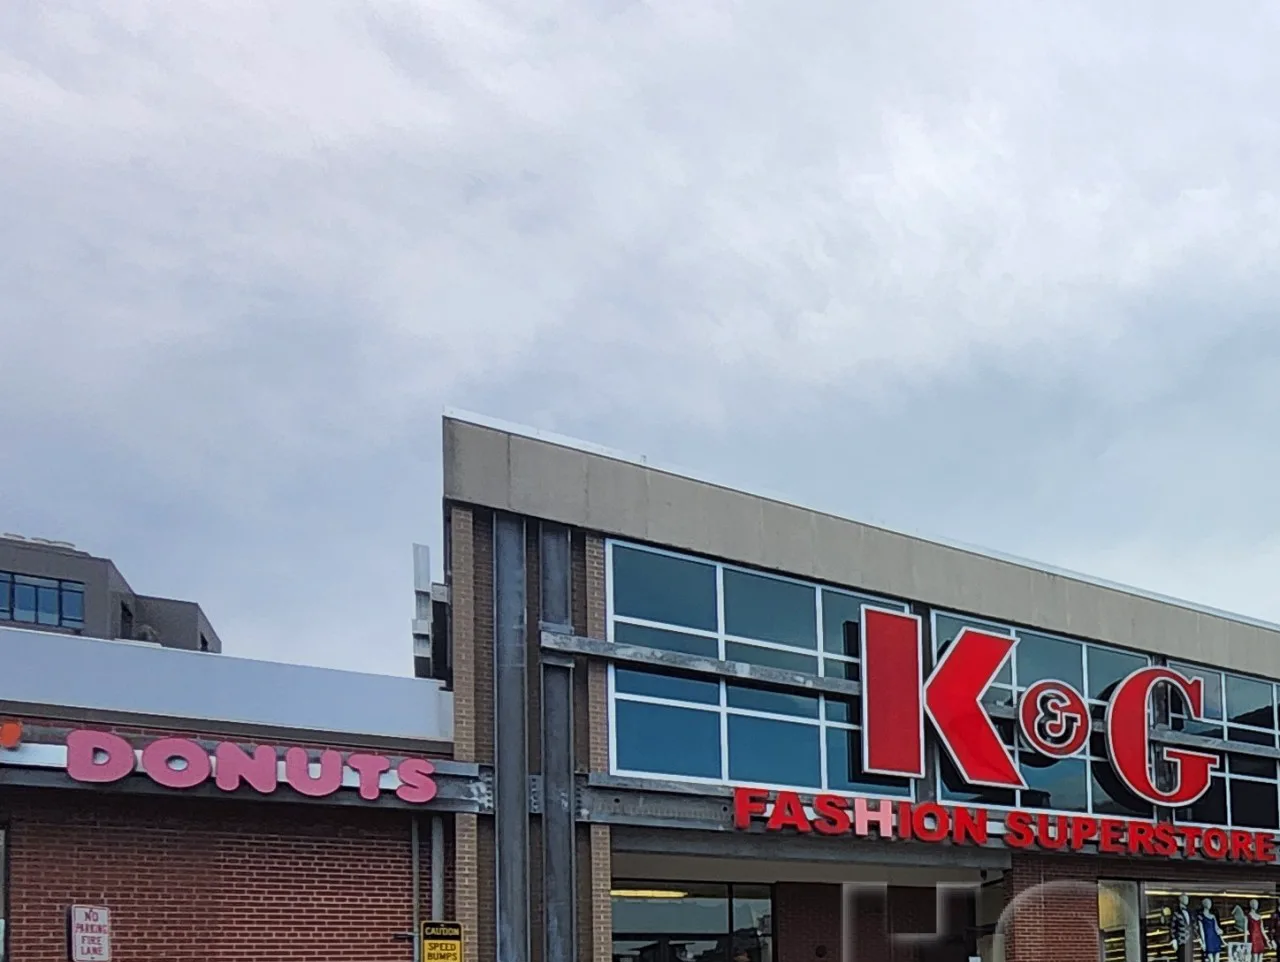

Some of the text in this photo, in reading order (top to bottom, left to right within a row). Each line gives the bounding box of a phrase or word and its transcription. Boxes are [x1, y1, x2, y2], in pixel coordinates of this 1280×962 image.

[861, 604, 1219, 807] K&G
[66, 729, 438, 803] DONUTS
[733, 788, 1277, 863] FASHION SUPERSTORE
[84, 911, 99, 922] NO
[75, 923, 108, 934] PARKING
[425, 927, 460, 936] CAUTION
[82, 936, 102, 945] FIRE
[81, 947, 104, 956] LANE
[428, 943, 457, 951] SPEED
[427, 952, 458, 961] BUMPS
